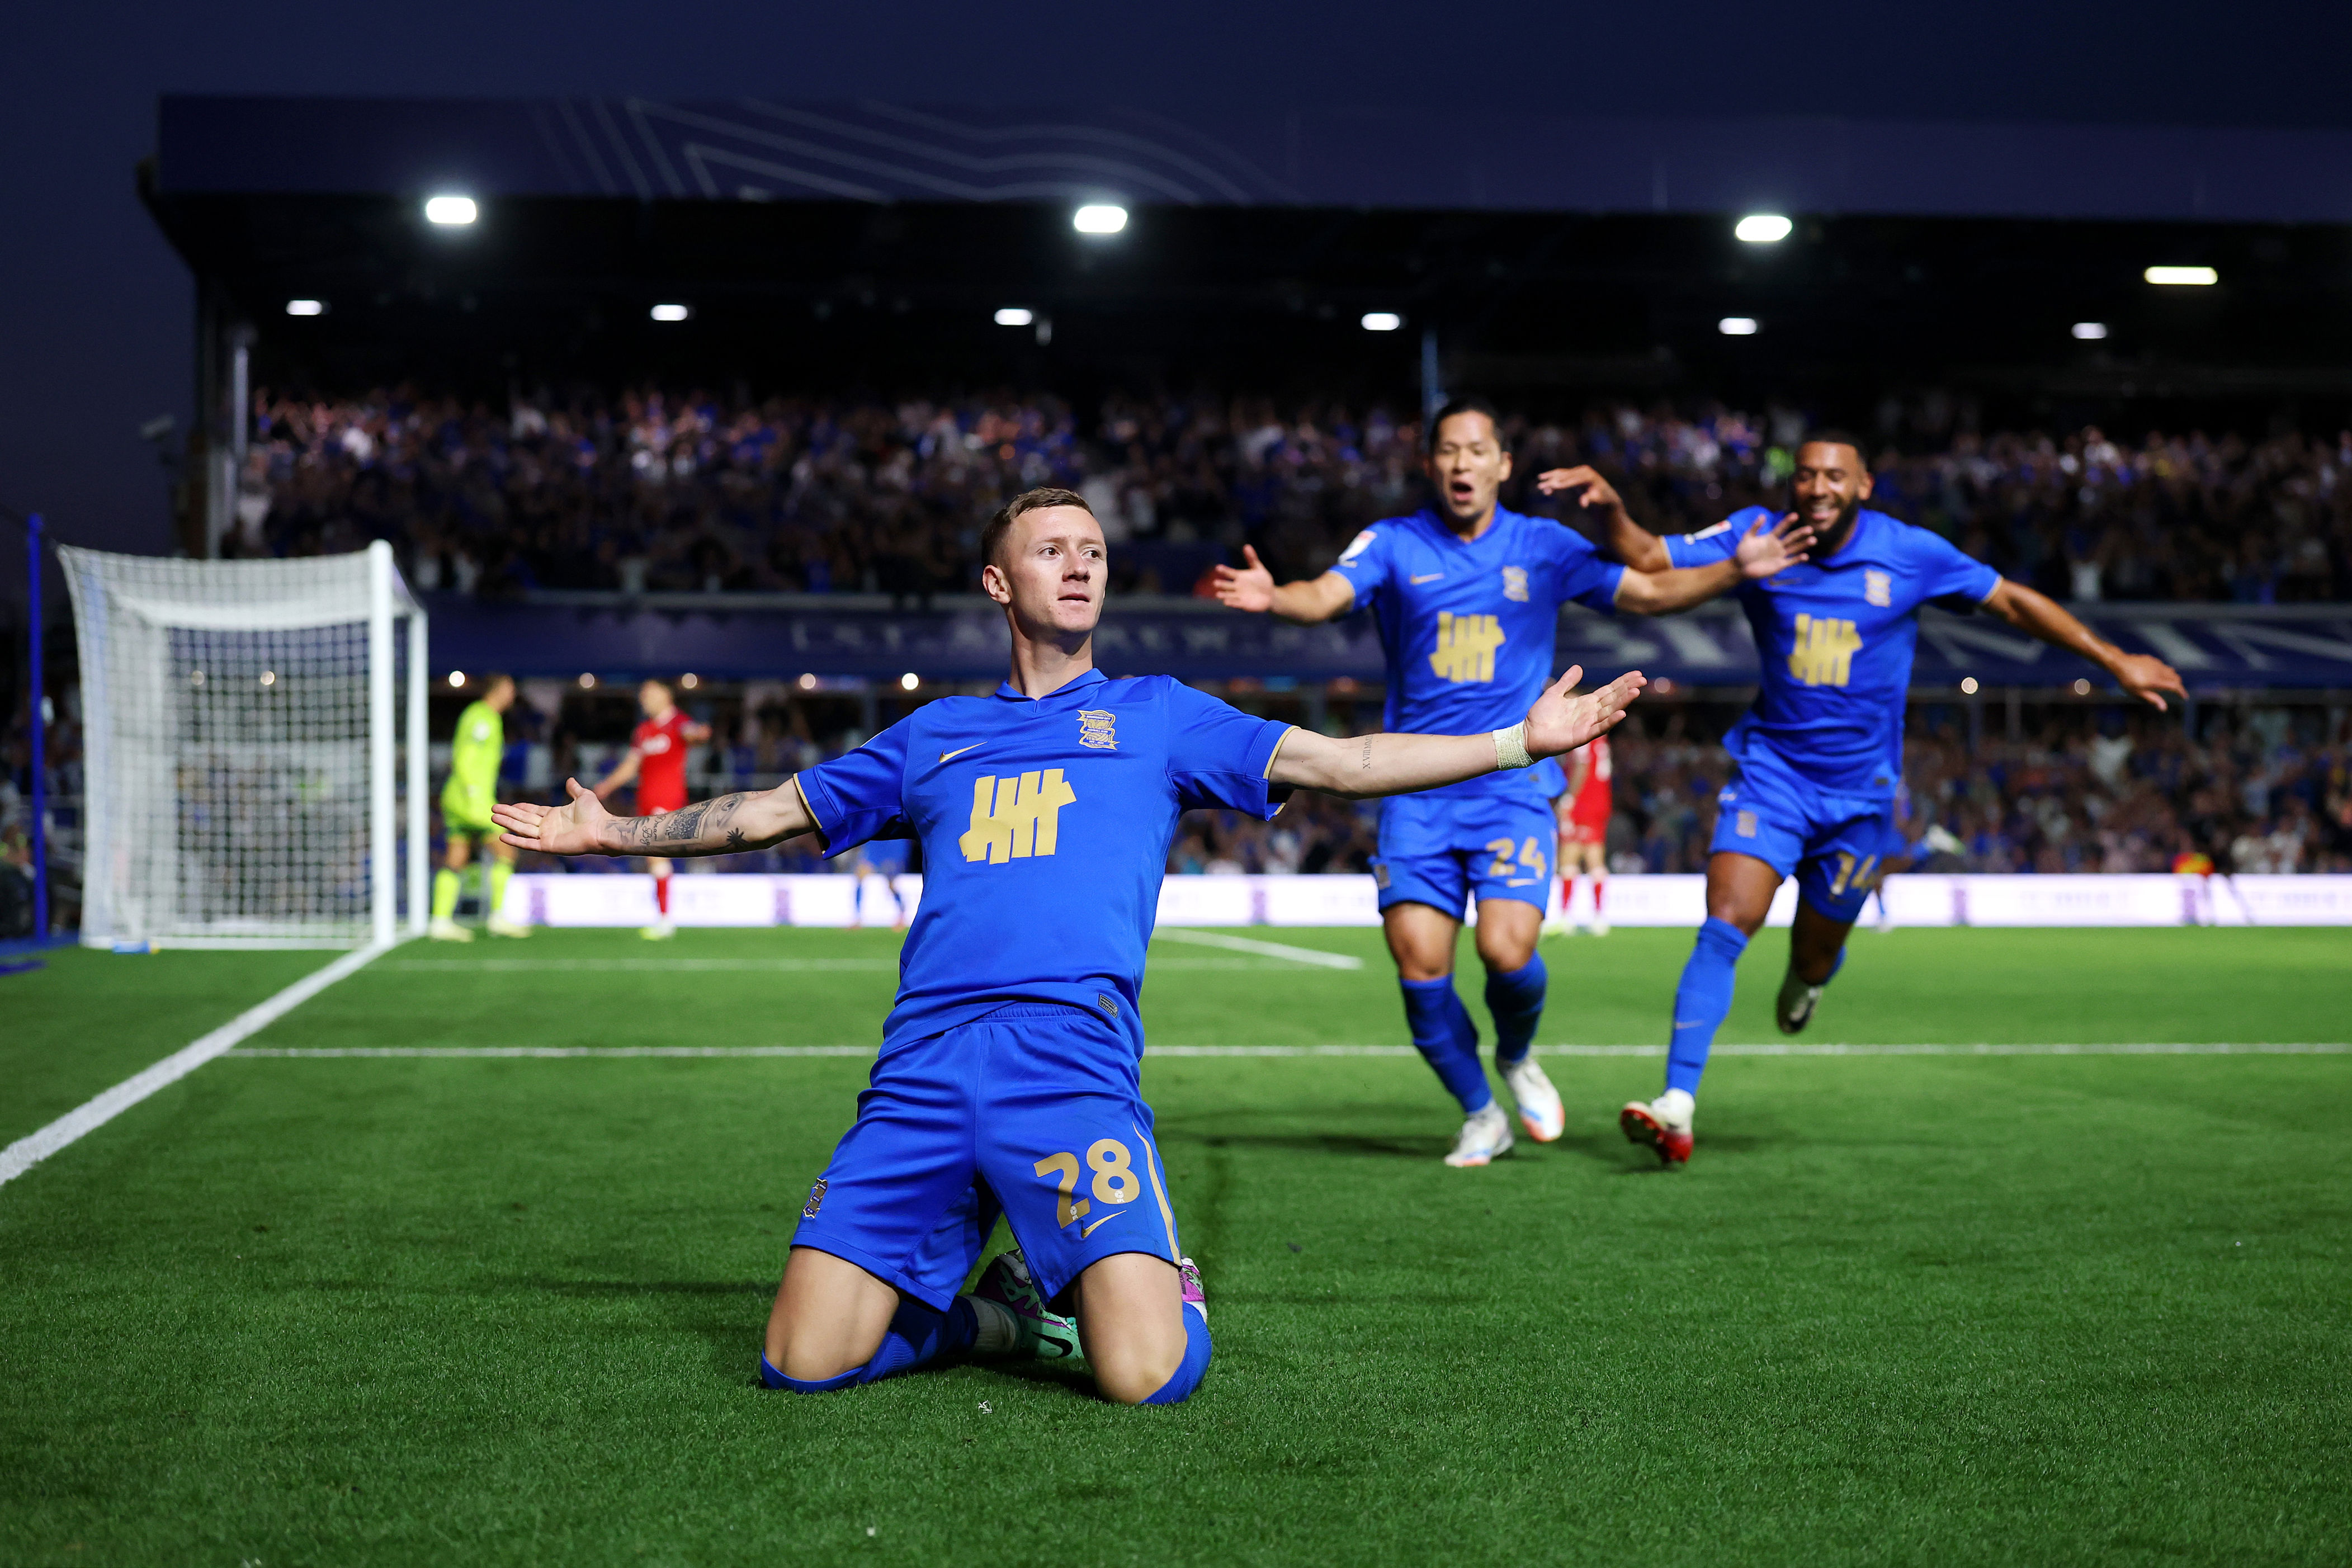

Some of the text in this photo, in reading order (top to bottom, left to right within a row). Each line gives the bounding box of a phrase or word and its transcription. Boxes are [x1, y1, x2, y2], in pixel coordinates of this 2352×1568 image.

[1485, 836, 1547, 880] 24
[1830, 852, 1877, 896] 14
[1033, 1138, 1141, 1229] 28
